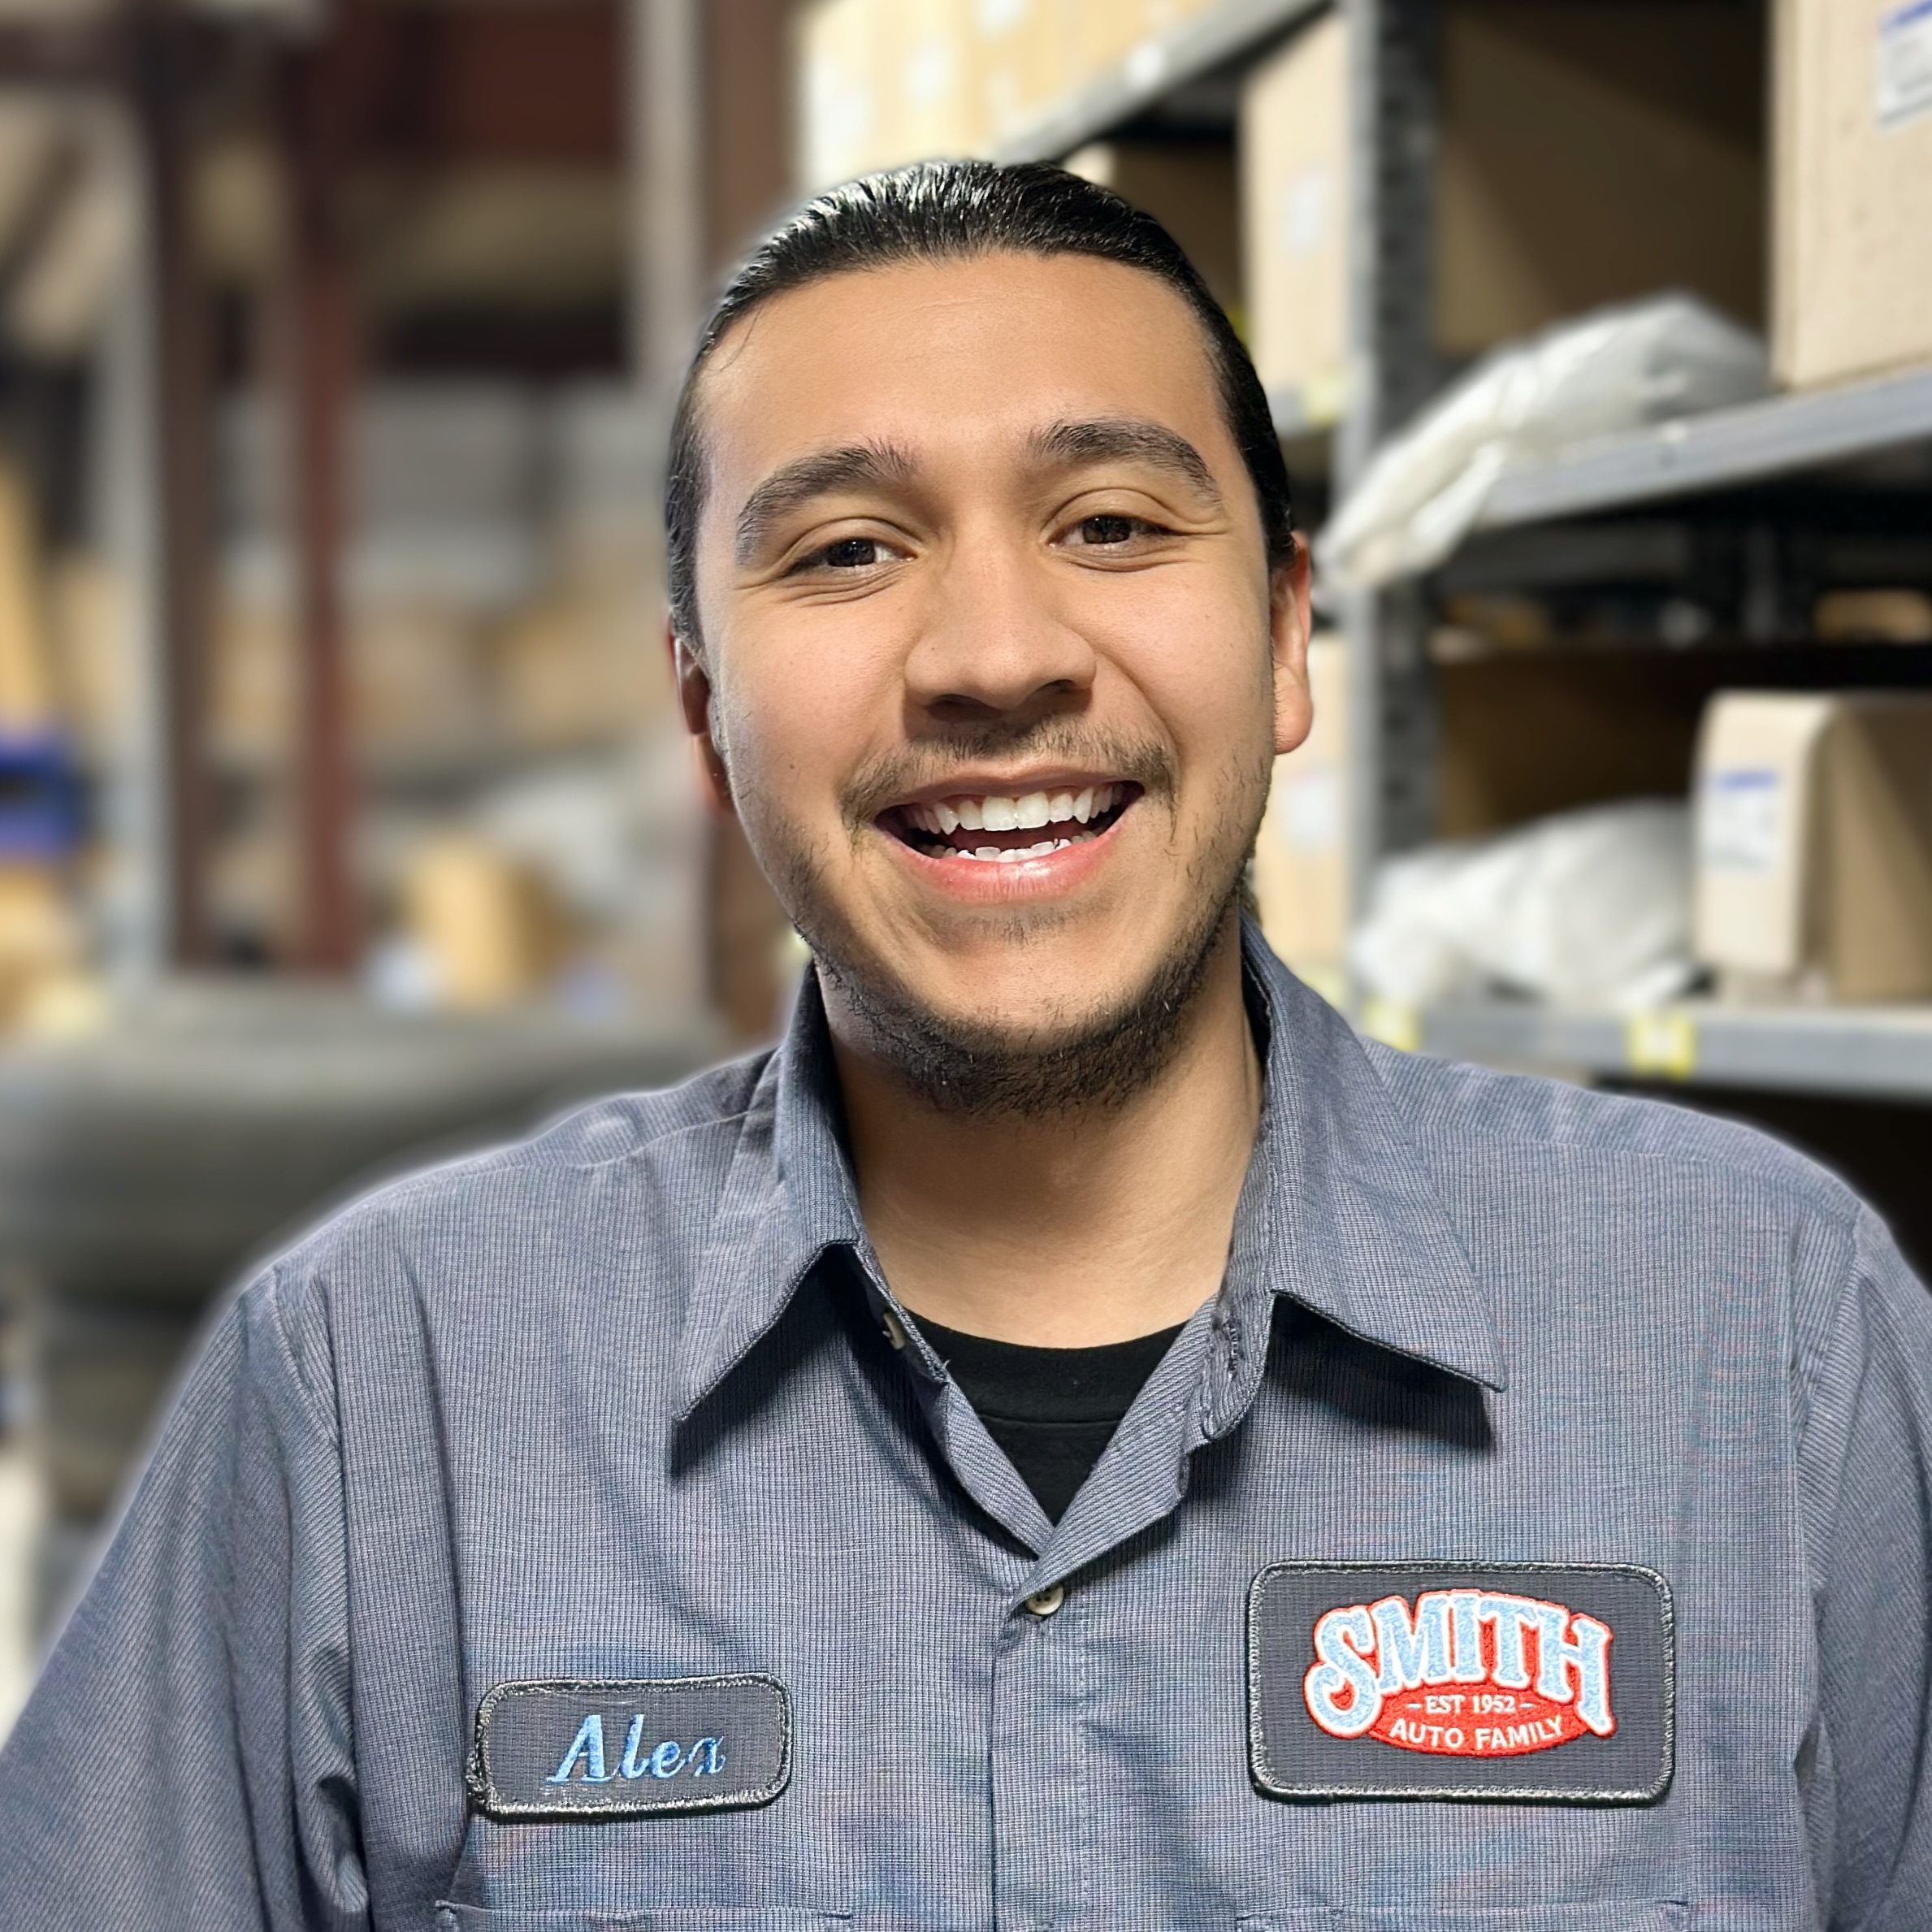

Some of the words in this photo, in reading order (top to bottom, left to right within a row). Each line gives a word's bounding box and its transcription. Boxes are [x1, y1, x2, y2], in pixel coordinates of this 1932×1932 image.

[1304, 1590, 1616, 1738] SMITH
[1425, 1694, 1463, 1714] EST
[1472, 1694, 1516, 1714] 1952
[546, 1713, 726, 1783] Alex
[1388, 1718, 1463, 1748] AUTO
[1475, 1715, 1564, 1750] FAMILY
